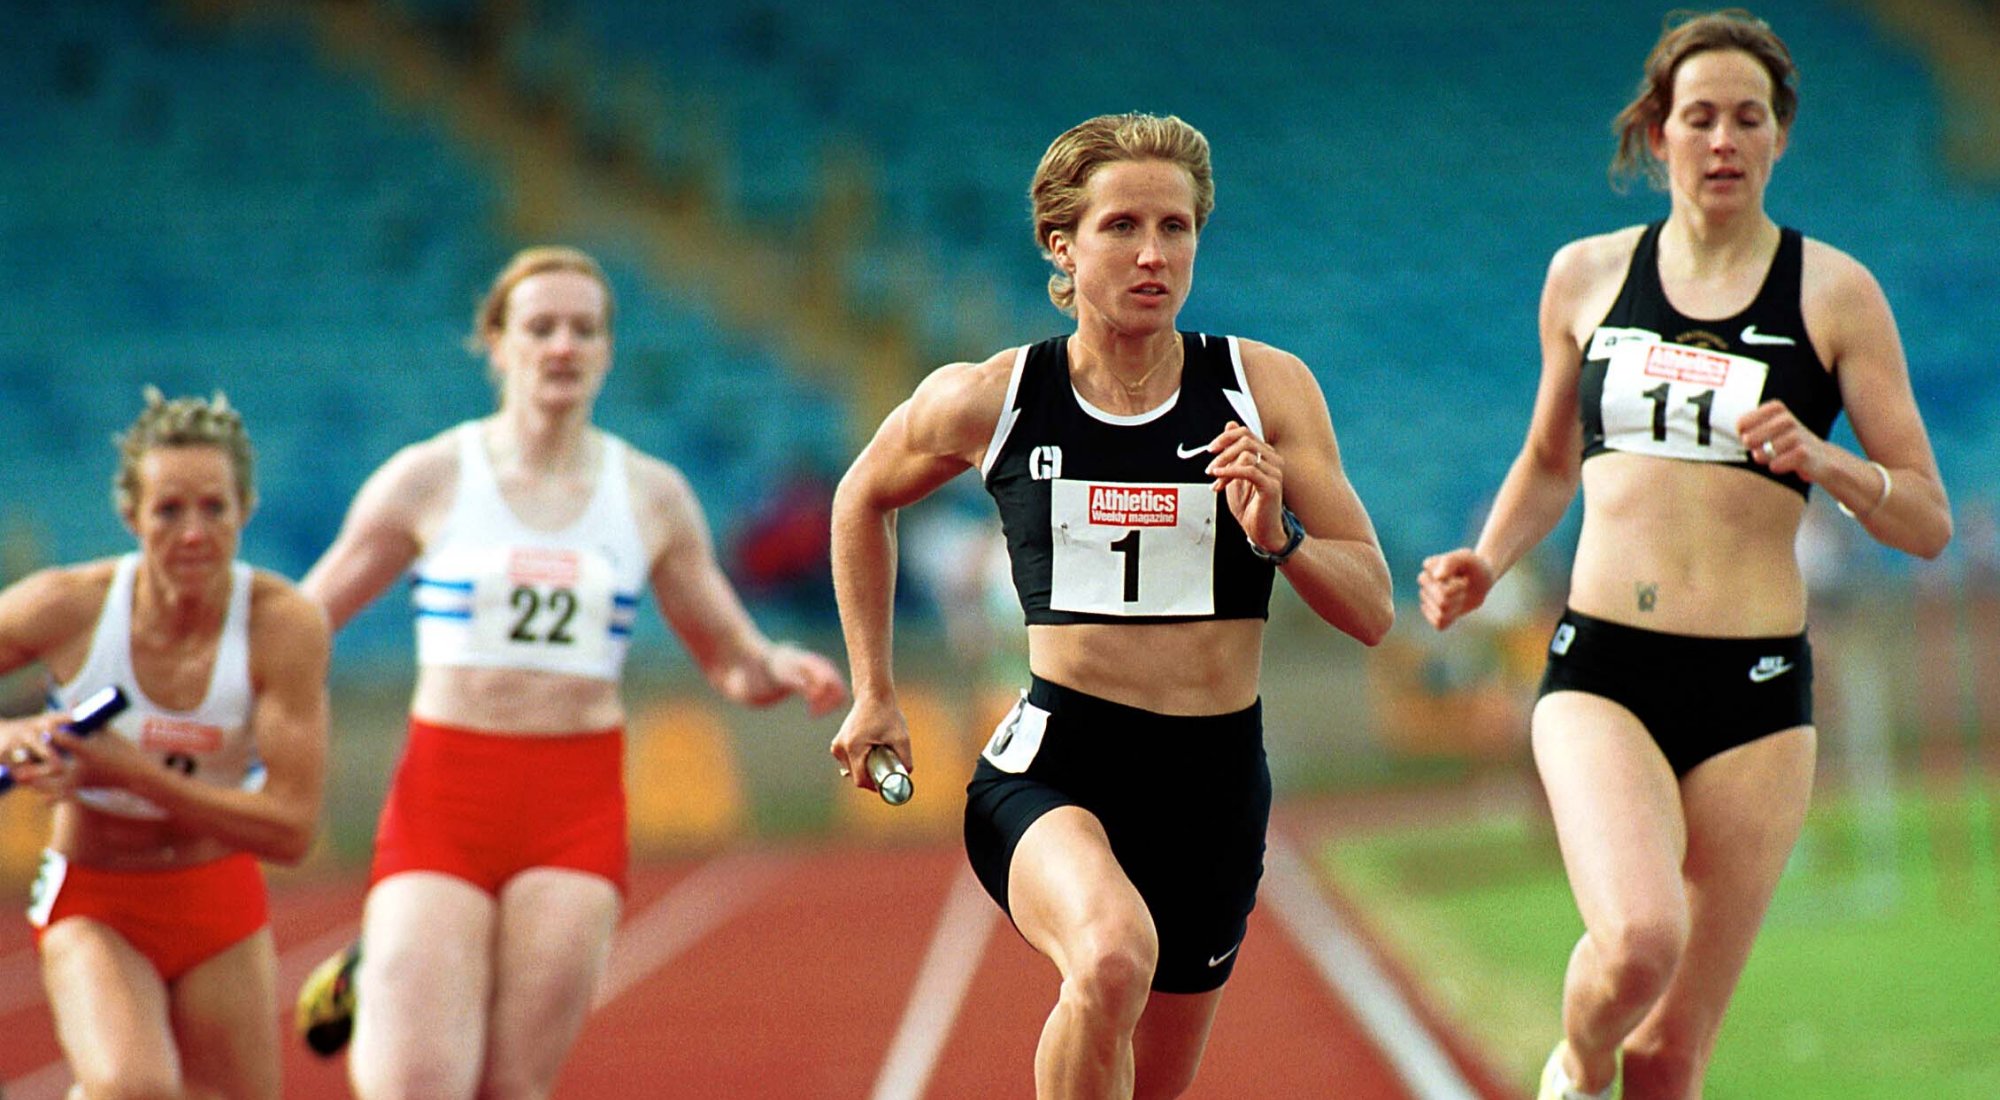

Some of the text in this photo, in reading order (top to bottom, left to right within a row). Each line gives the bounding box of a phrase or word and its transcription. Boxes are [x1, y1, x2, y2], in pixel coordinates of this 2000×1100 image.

[1643, 383, 1715, 446] 11
[1091, 488, 1175, 512] Athletics
[1092, 509, 1175, 524] Weekly magazine
[1110, 529, 1141, 602] 1
[509, 585, 578, 643] 22
